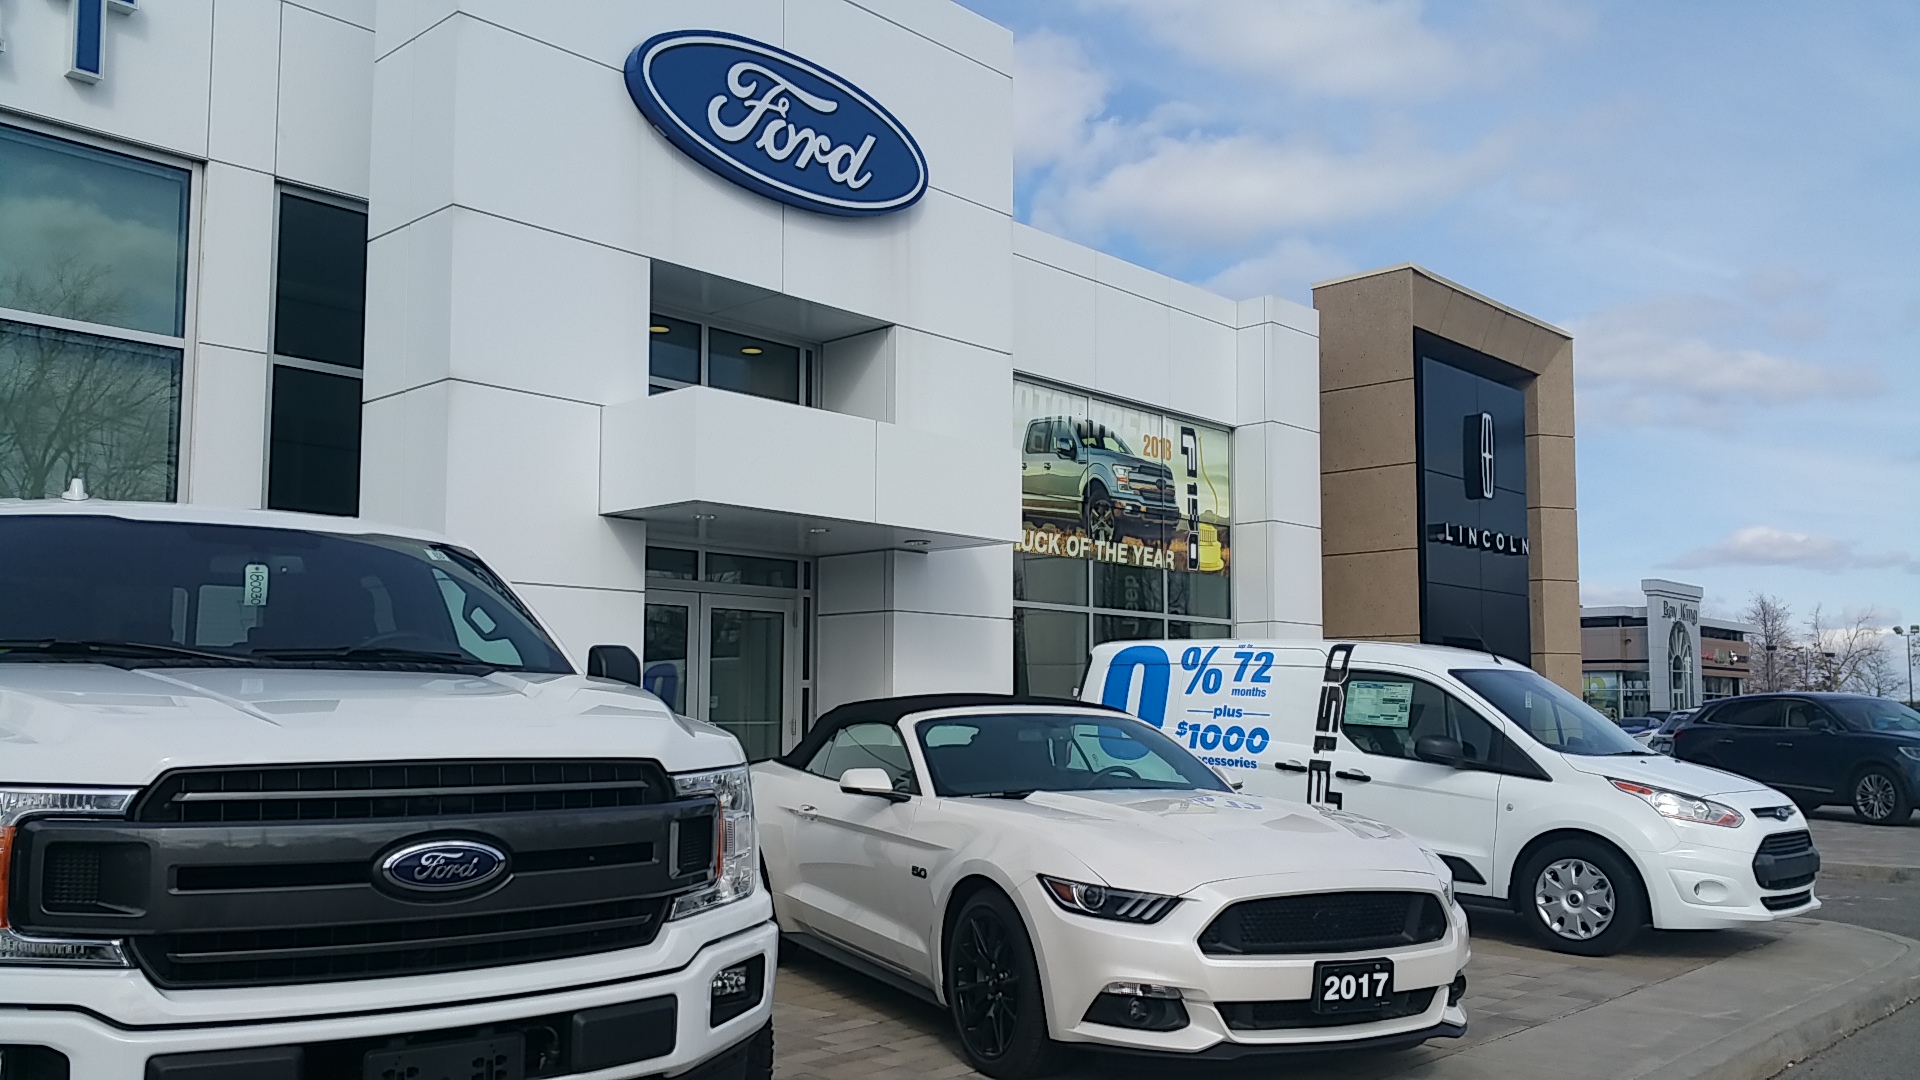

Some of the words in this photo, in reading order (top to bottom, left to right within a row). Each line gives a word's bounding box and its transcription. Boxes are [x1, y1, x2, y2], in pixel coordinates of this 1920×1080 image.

[707, 61, 878, 190] Ford
[1142, 433, 1173, 462] 2018
[1015, 529, 1061, 555] UCK
[1066, 535, 1094, 558] OF
[1094, 539, 1129, 564] THE
[1132, 544, 1175, 572] YEAR
[1445, 522, 1530, 555] LINCOLN
[1663, 600, 1678, 623] Bay
[1680, 602, 1698, 627] King
[1232, 651, 1275, 684] 72
[1230, 687, 1267, 698] months
[1212, 704, 1244, 720] plus
[1174, 720, 1270, 755] $1000
[1197, 755, 1258, 769] cessories
[413, 851, 480, 881] Ford
[1323, 971, 1390, 1001] 2017
